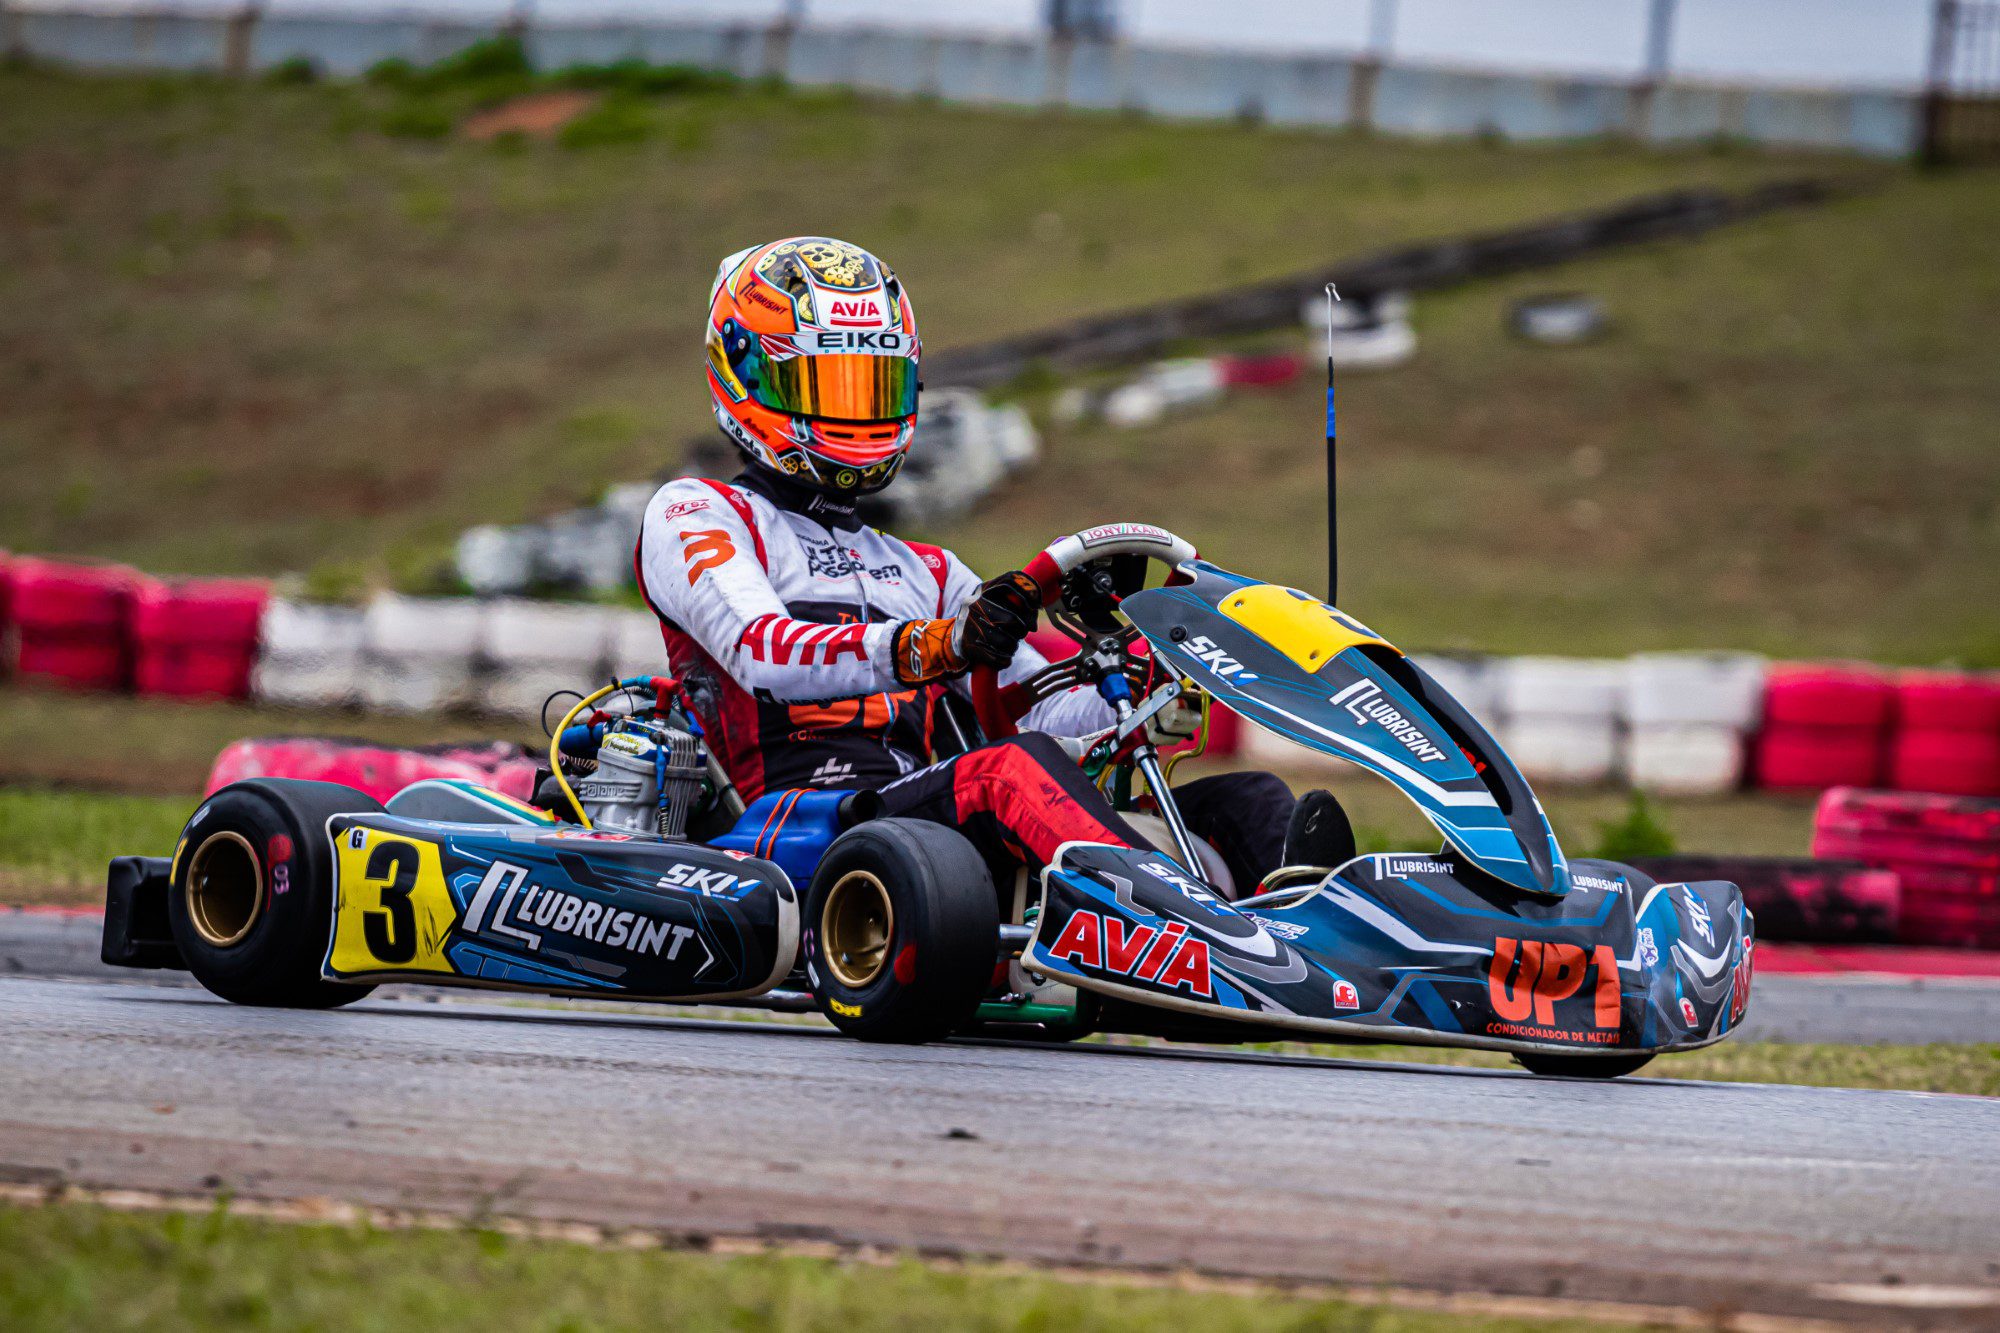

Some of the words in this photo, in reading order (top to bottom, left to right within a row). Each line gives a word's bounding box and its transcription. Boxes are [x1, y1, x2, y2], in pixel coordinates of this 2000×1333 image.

[817, 332, 900, 349] EIKO
[1361, 698, 1447, 762] LUBRISINT
[351, 829, 364, 849] G
[1393, 860, 1454, 875] LUBRISINT
[1573, 874, 1624, 894] LUBRISINT
[363, 840, 421, 965] 3
[516, 884, 694, 961] LUBRISINT
[1488, 936, 1622, 1028] UP1
[1486, 1022, 1570, 1040] CONDICIONADOR
[1571, 1031, 1585, 1042] DE
